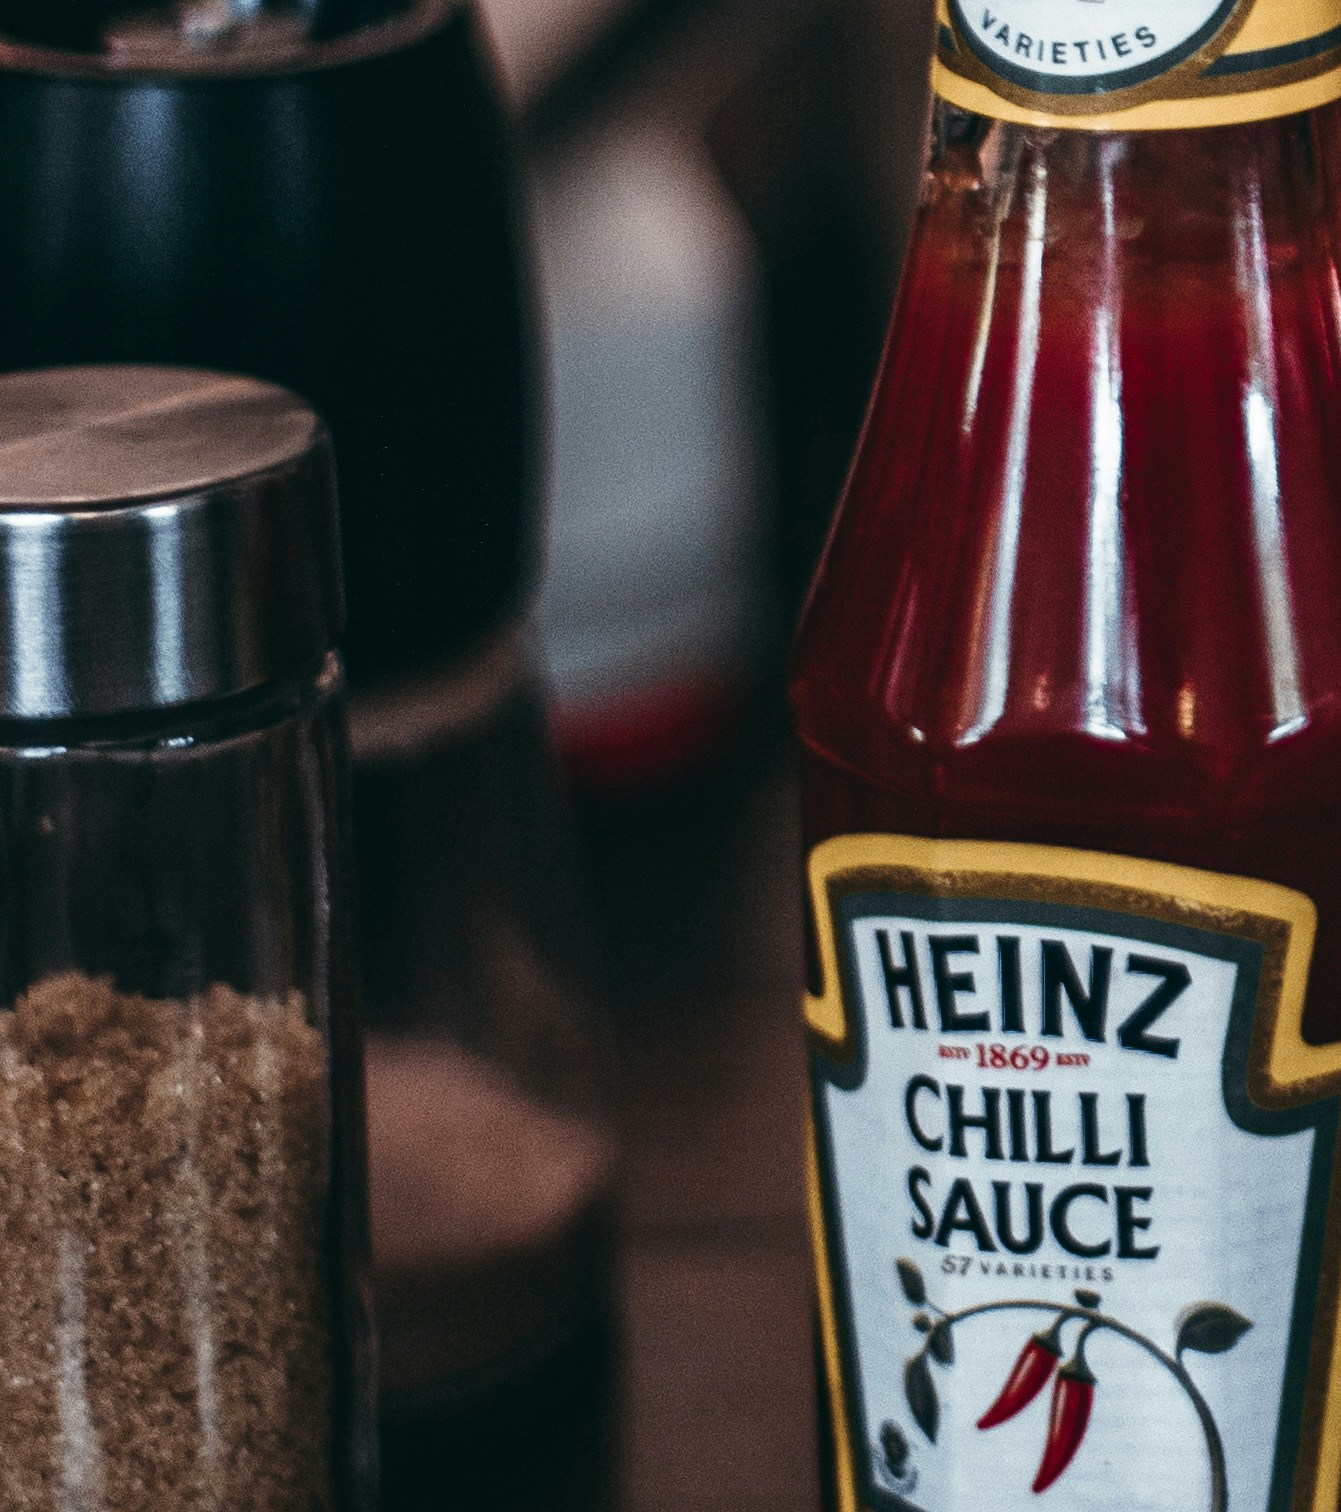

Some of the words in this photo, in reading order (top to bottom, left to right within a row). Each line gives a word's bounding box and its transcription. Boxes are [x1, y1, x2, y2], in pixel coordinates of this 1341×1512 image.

[980, 8, 1158, 65] VARIETIES
[875, 927, 1192, 1059] HEINZ
[975, 1042, 1051, 1070] 1869
[904, 1075, 1152, 1168] CHILLI
[906, 1166, 1162, 1261] SAUCE
[940, 1253, 974, 1277] 57
[979, 1260, 1114, 1282] VARIETIES
